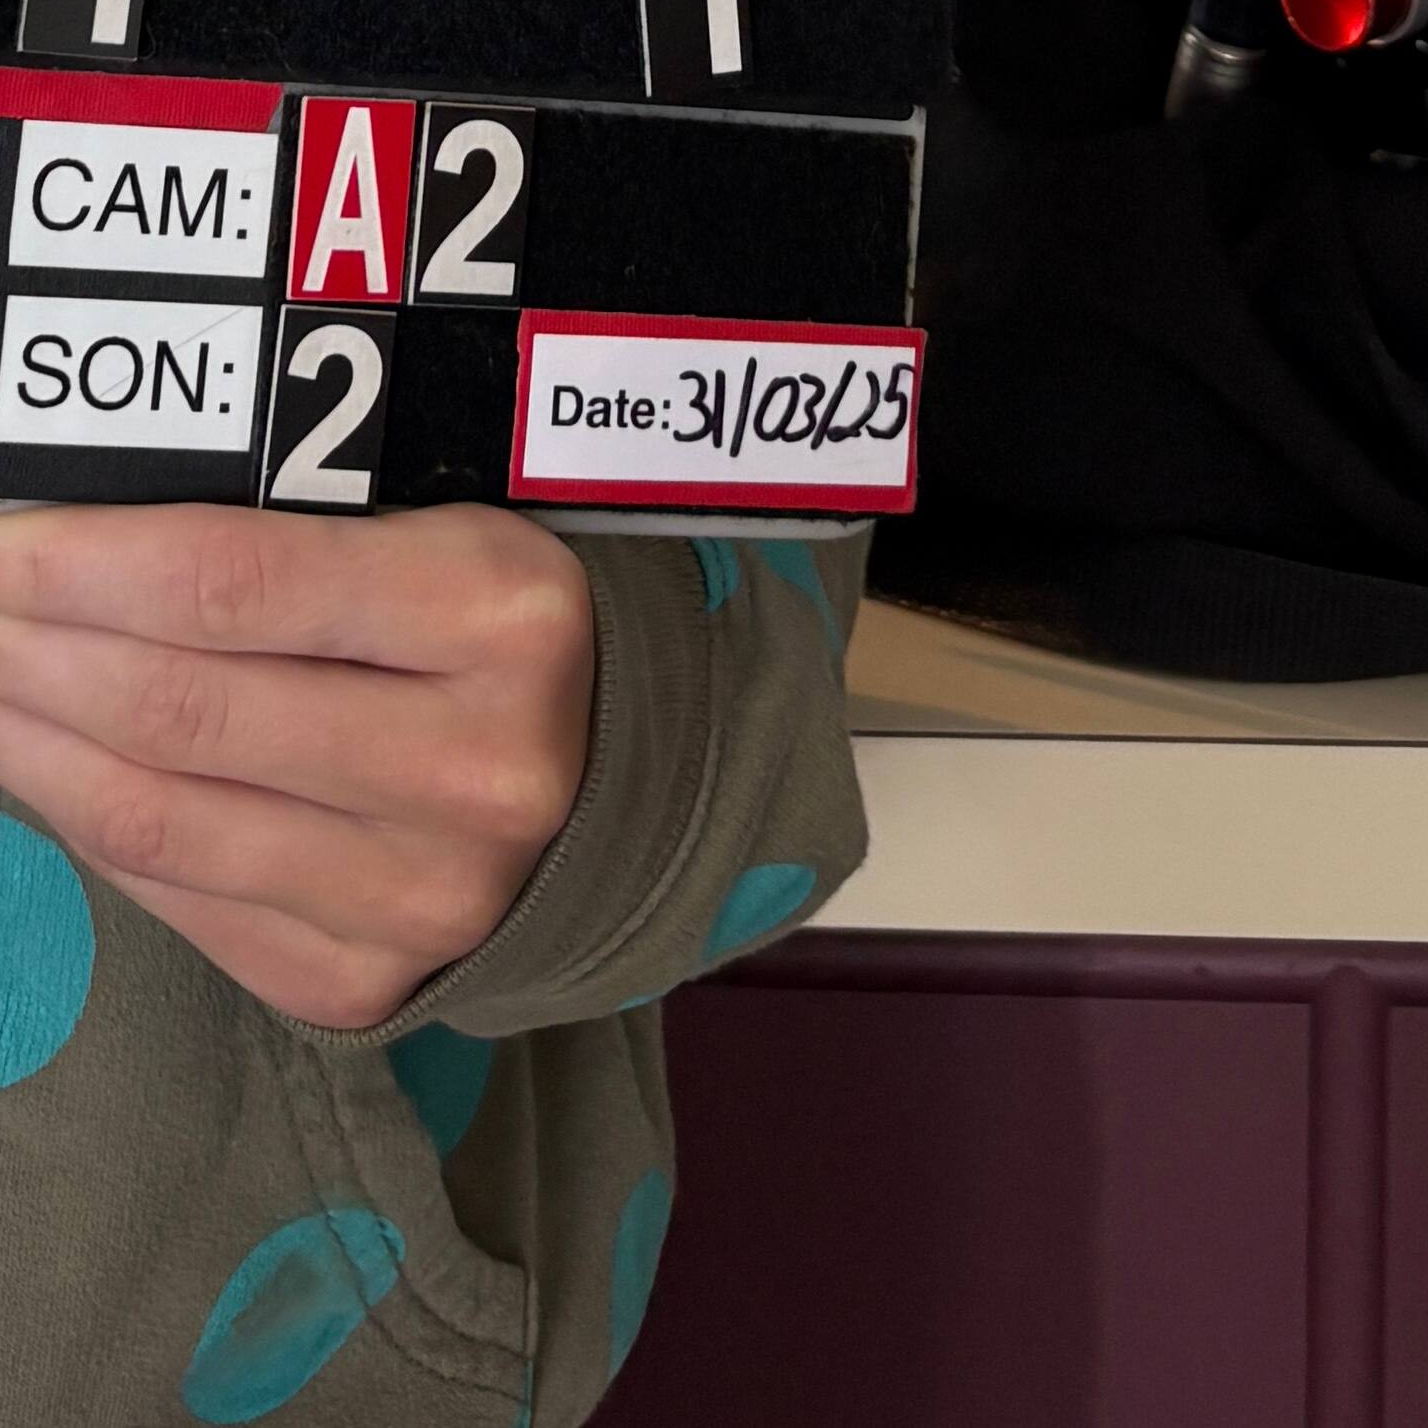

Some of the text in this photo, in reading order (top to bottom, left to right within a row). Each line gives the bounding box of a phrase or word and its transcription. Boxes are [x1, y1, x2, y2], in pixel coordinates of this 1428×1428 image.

[33, 158, 251, 239] CAM:
[18, 323, 384, 505] SON: 2
[552, 386, 670, 430] Date:
[673, 358, 911, 457] 31/03/25
